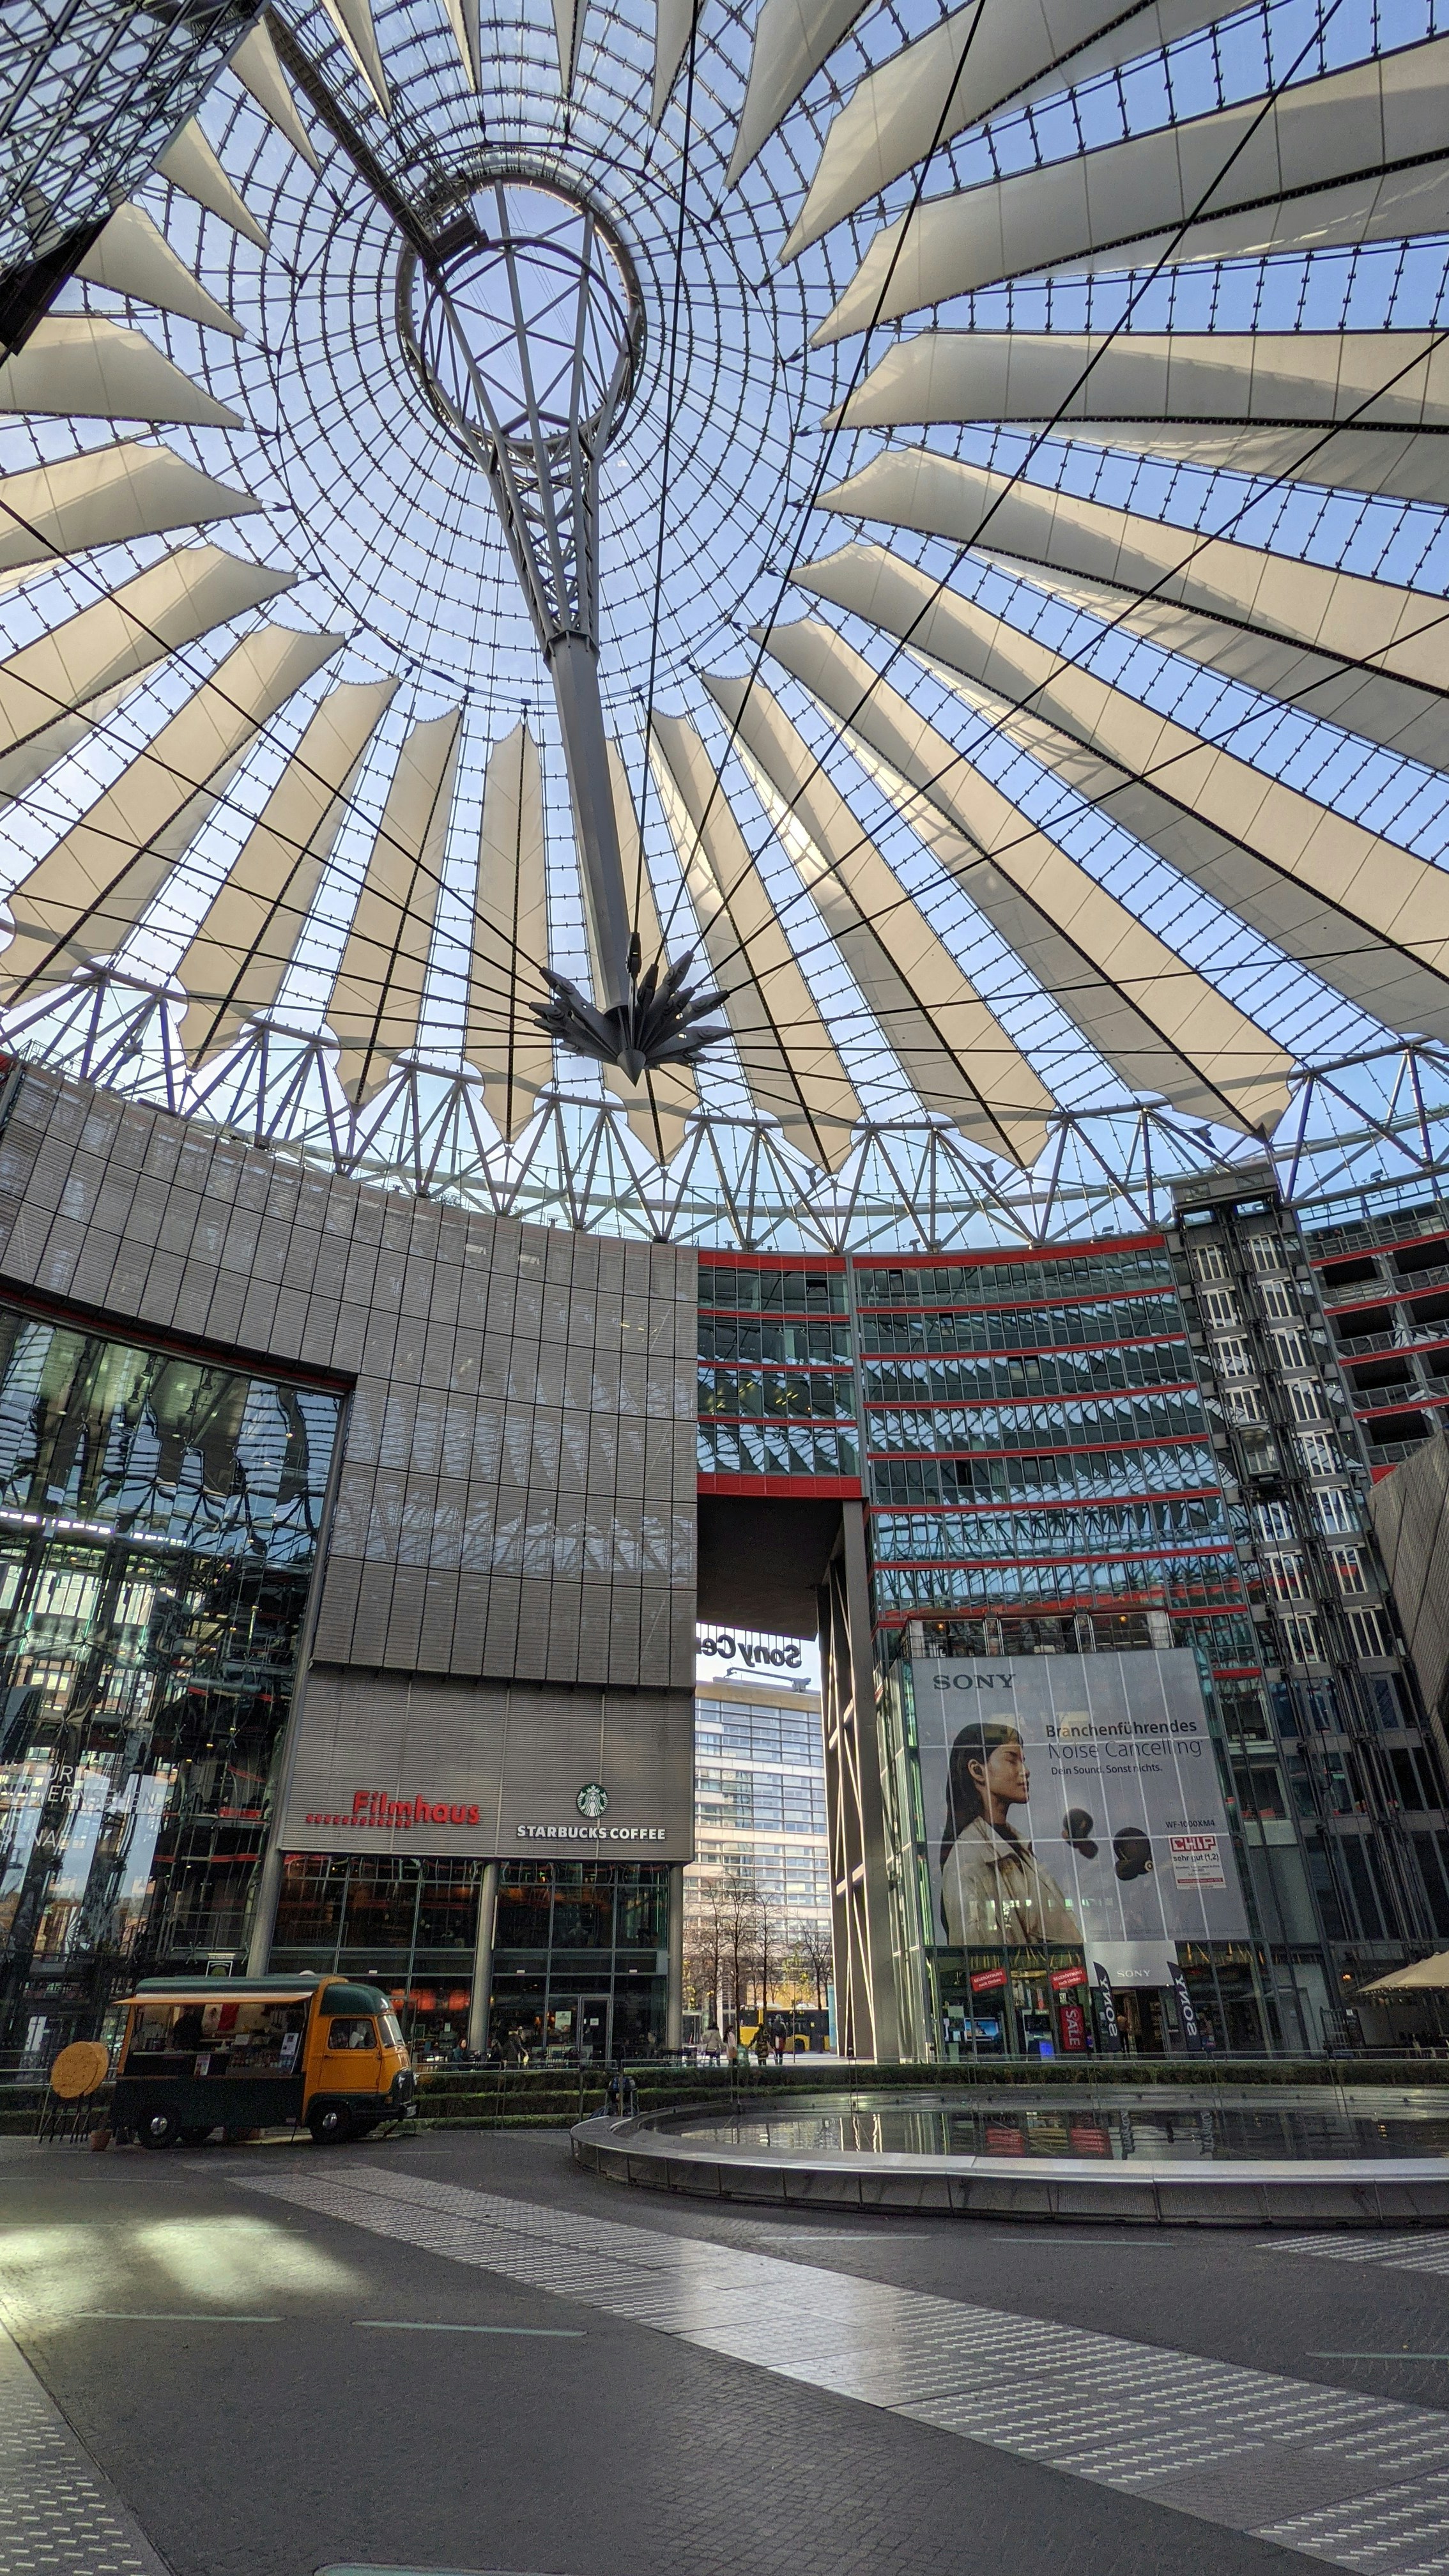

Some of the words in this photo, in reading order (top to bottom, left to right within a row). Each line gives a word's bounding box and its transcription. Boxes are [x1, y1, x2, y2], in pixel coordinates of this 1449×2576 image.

[933, 1674, 1016, 1690] SONY
[1046, 1719, 1197, 1737] Branchenführendes
[1048, 1742, 1098, 1759] Noise
[1051, 1767, 1071, 1775] Dein
[1106, 1765, 1131, 1774] Sonst
[353, 1791, 480, 1825] Filmhaus
[1165, 1820, 1215, 1828] WF-1000XM4
[517, 1825, 606, 1839] STARBUCKS
[610, 1828, 665, 1840] COFFEE
[1170, 1836, 1215, 1851] CHIP
[1204, 1853, 1219, 1862] (1,2)
[1066, 2009, 1080, 2046] SALE
